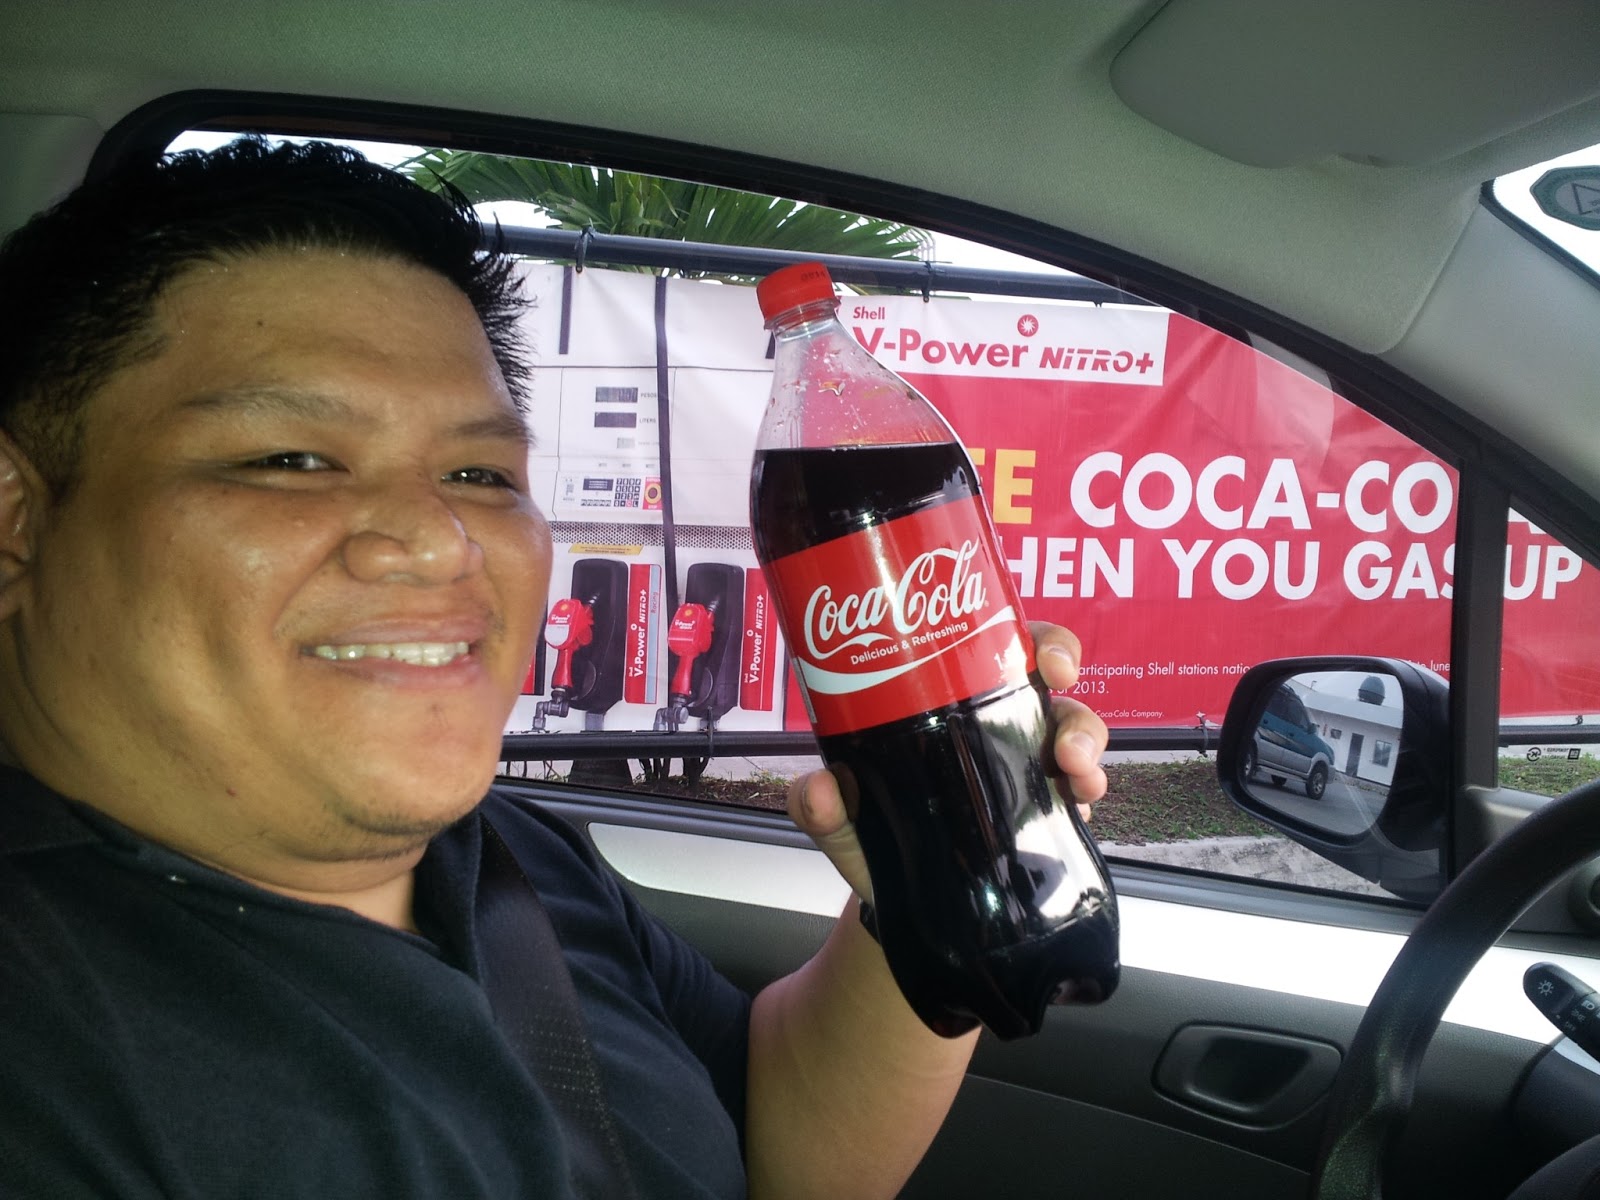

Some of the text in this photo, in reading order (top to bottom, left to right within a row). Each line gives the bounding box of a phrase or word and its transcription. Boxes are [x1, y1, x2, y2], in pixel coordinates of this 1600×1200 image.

[852, 305, 886, 320] Shell
[852, 326, 1029, 369] V-Power
[1070, 451, 1547, 534] COCA-CO
[1000, 536, 1134, 598] HEN
[1161, 538, 1320, 600] YOU
[1503, 545, 1583, 600] UP
[634, 626, 646, 677] V-Power
[749, 632, 762, 684] V-Power
[850, 621, 969, 666] Delicious & Refreshing
[1073, 680, 1109, 694] 2013.
[1078, 661, 1252, 679] articipating Shell stations natio
[1131, 709, 1165, 719] Company.
